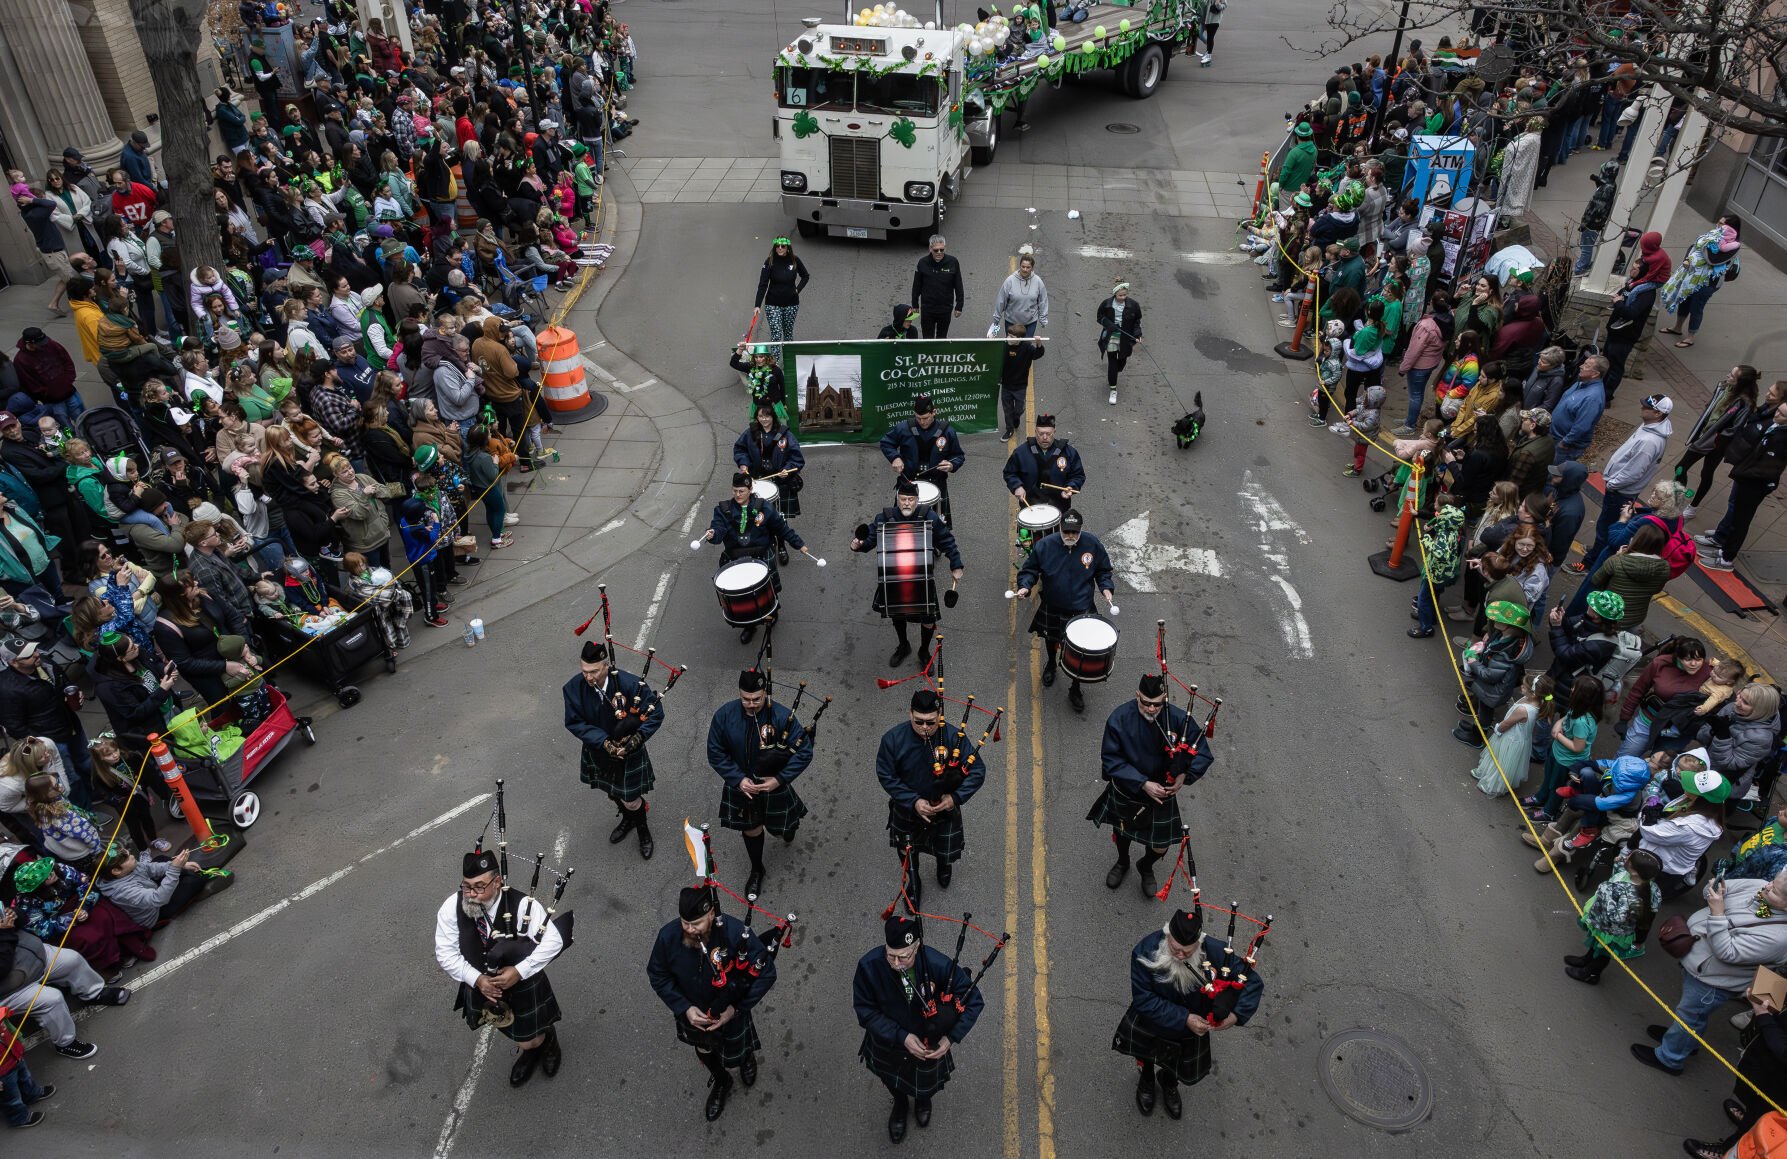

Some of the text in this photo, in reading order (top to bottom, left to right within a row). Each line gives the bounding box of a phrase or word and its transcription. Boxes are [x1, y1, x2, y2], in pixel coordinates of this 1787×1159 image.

[792, 87, 801, 104] 6
[1430, 155, 1464, 168] ATM
[124, 202, 146, 221] 87
[895, 353, 976, 366] ST. PATRICK
[880, 363, 989, 380] CO-CATHEDRAL
[934, 376, 967, 384] BILLINGS,
[932, 387, 956, 396] TIMES:
[954, 404, 978, 412] 5:00PM
[948, 414, 976, 422] 10:30AM
